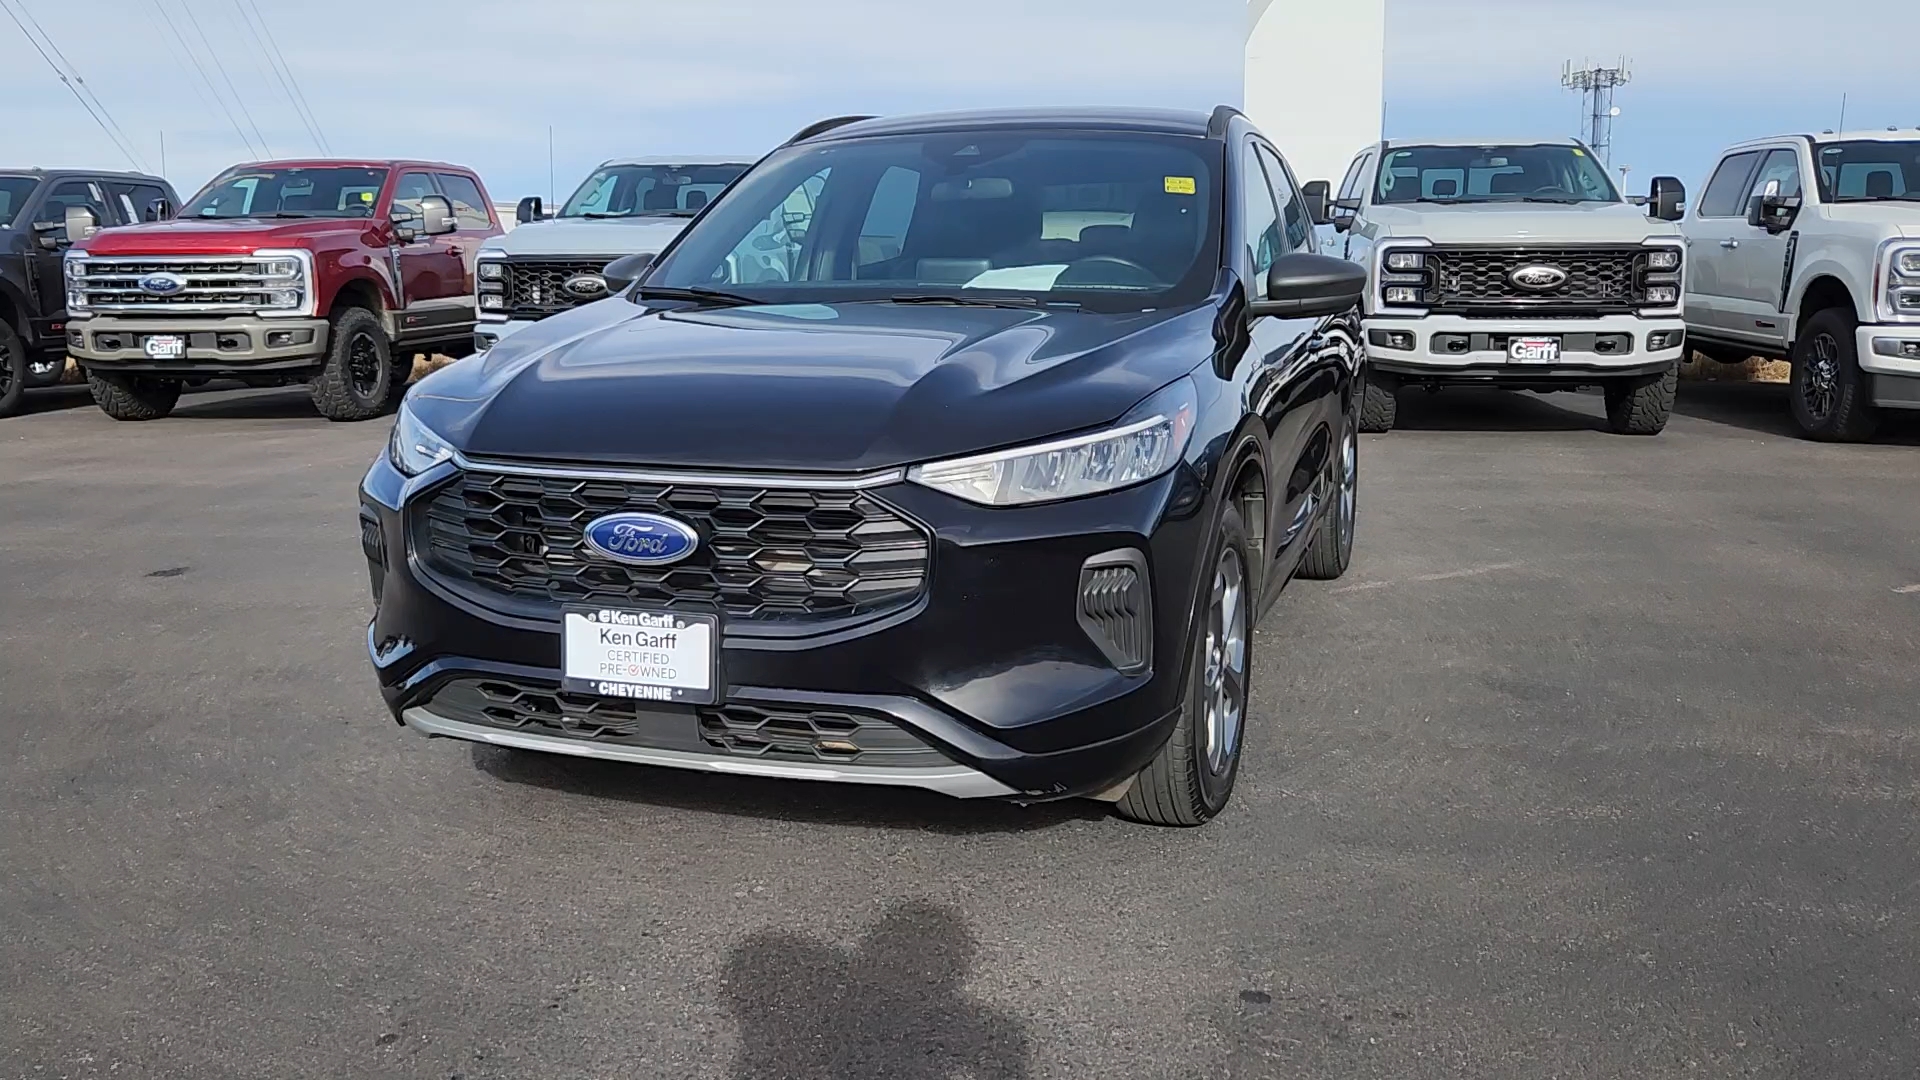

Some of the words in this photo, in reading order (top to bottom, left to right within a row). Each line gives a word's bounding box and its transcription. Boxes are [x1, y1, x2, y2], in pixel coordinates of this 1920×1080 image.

[1525, 271, 1554, 283] Ford
[146, 339, 183, 355] Garff
[1511, 341, 1558, 360] Garff
[608, 523, 669, 554] Ford
[611, 610, 638, 625] Ken
[639, 612, 675, 628] Garff
[600, 628, 632, 645] Ken
[636, 631, 677, 649] Garff
[607, 649, 669, 665] CERTIFIED
[598, 682, 672, 700] CHEYENNE
